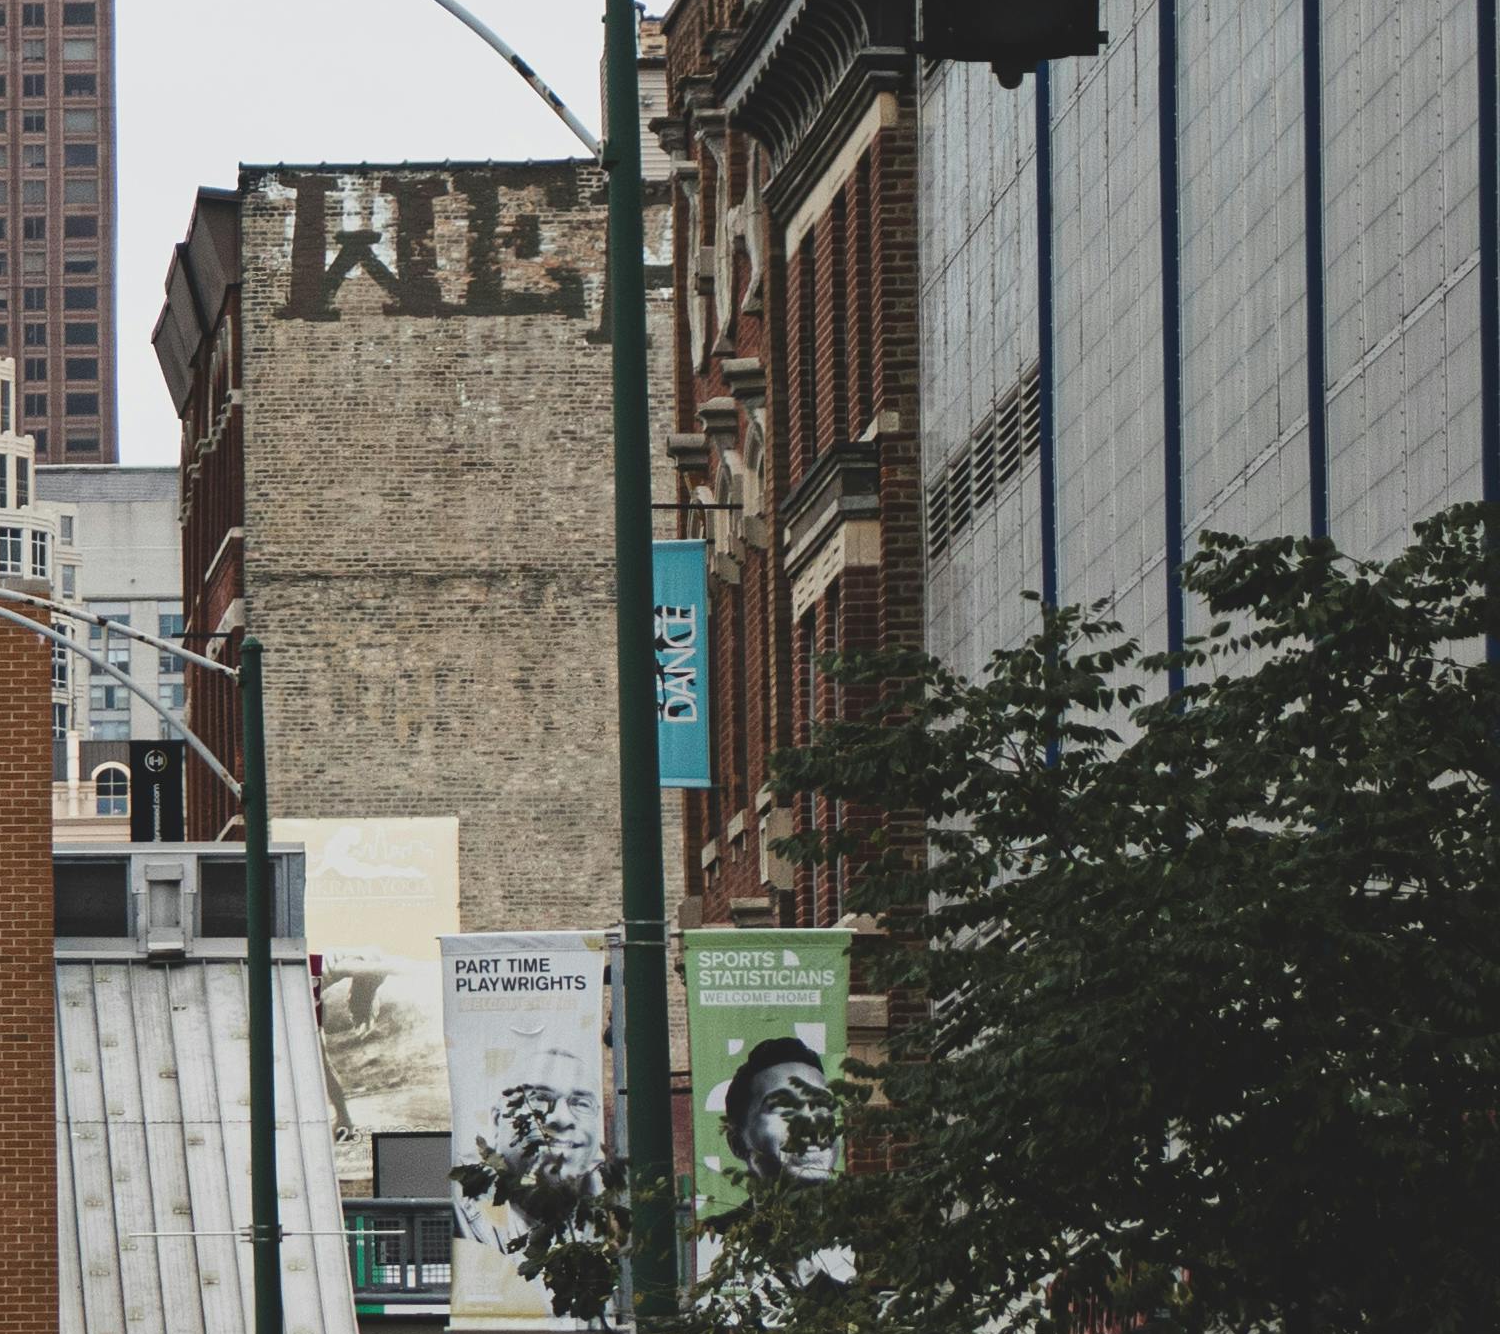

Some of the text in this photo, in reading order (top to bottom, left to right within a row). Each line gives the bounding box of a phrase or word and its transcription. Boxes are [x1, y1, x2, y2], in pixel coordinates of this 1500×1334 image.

[662, 604, 697, 723] DANCE
[455, 957, 550, 974] PART TIME
[699, 951, 775, 967] SPORTS
[456, 975, 586, 992] PLAYWRIGHTS
[699, 969, 835, 986] STATISTICIANS
[704, 991, 817, 1003] WELCOME HOME
